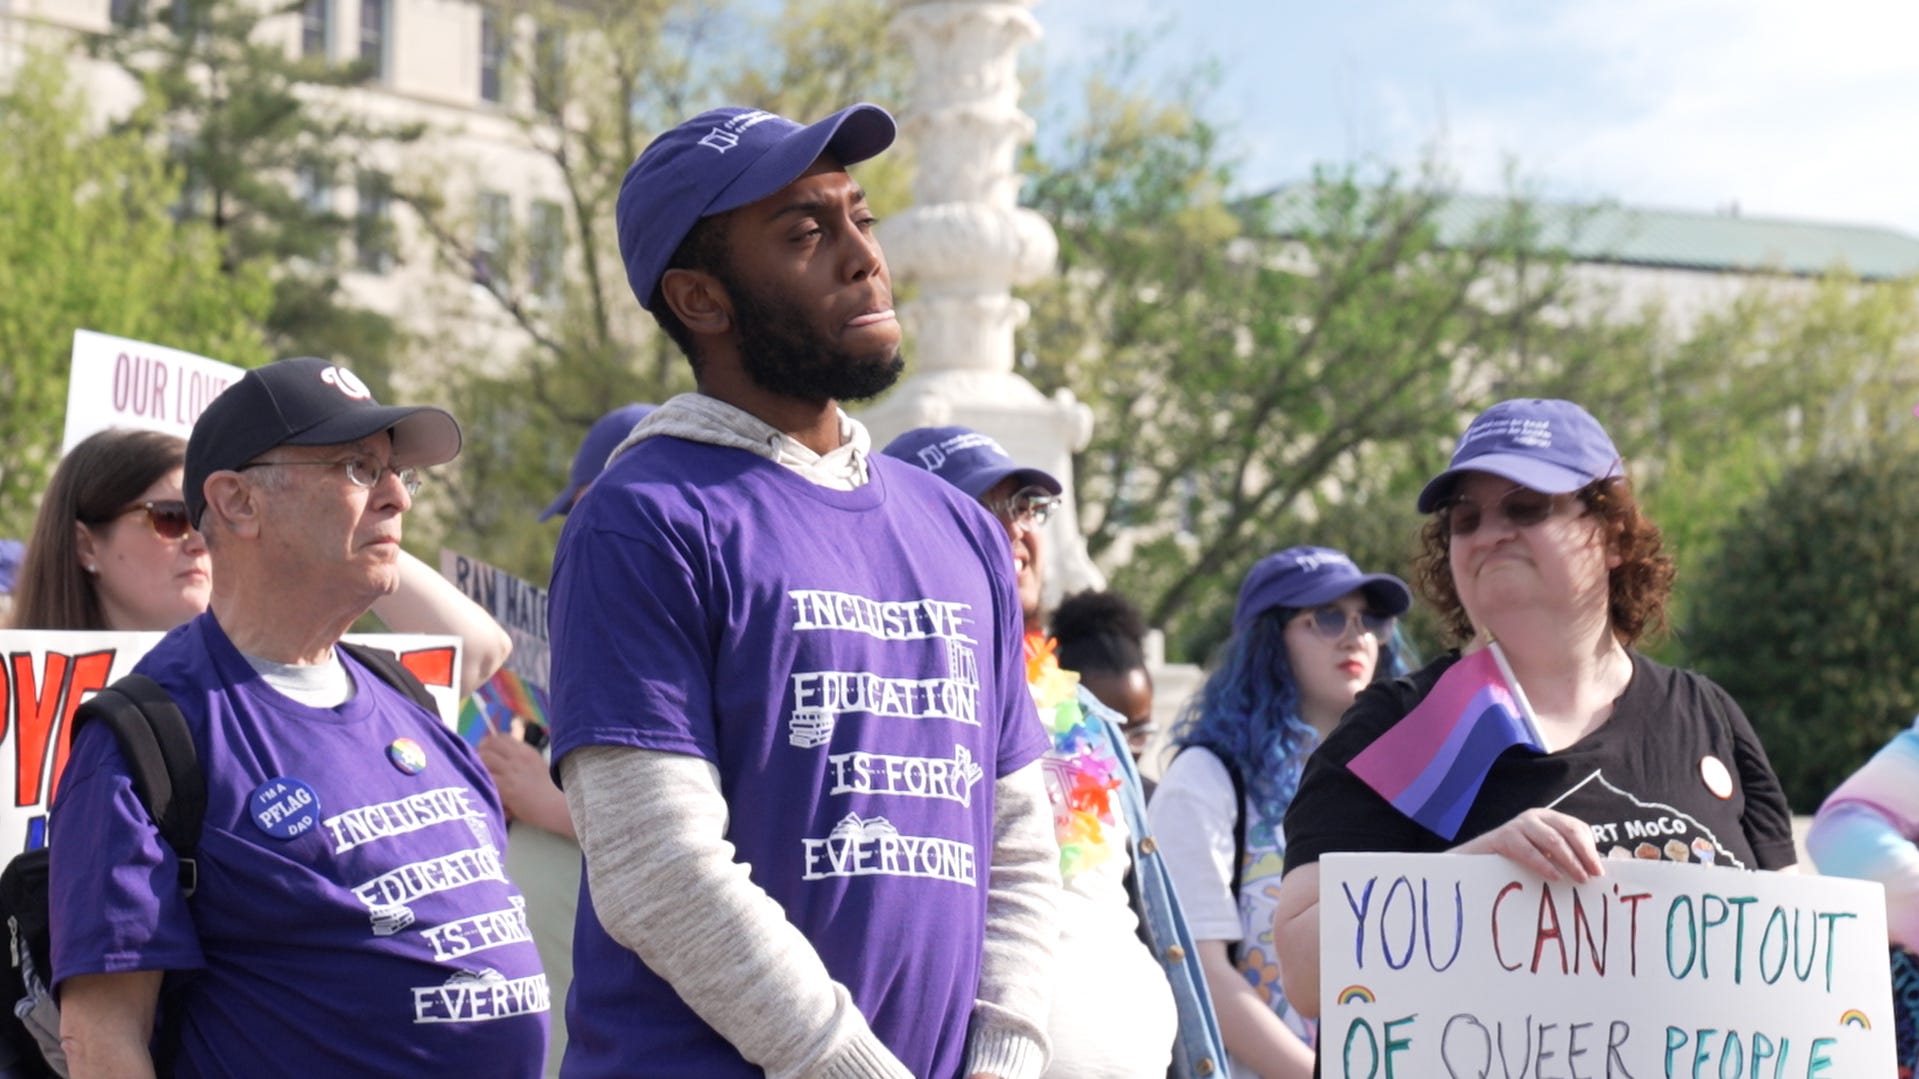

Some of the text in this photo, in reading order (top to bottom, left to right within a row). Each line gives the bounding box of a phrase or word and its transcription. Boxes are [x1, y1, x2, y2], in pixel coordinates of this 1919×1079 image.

[113, 353, 229, 424] OUR LOV
[789, 590, 976, 644] INCLUSIVE
[791, 672, 980, 727] EDUCATION
[276, 783, 287, 794] A
[829, 755, 952, 797] IS FOR
[258, 788, 312, 829] PFLAG
[288, 815, 313, 835] DAD
[323, 787, 486, 854] INCLUSIVE
[1624, 817, 1687, 840] MoCo
[801, 838, 976, 887] EVERYONE
[421, 909, 522, 961] IS FOR
[1342, 876, 1464, 972] YOU
[1491, 881, 1653, 978] CAN'T
[1343, 1014, 1418, 1079] OF
[1441, 1014, 1636, 1079] QUEER
